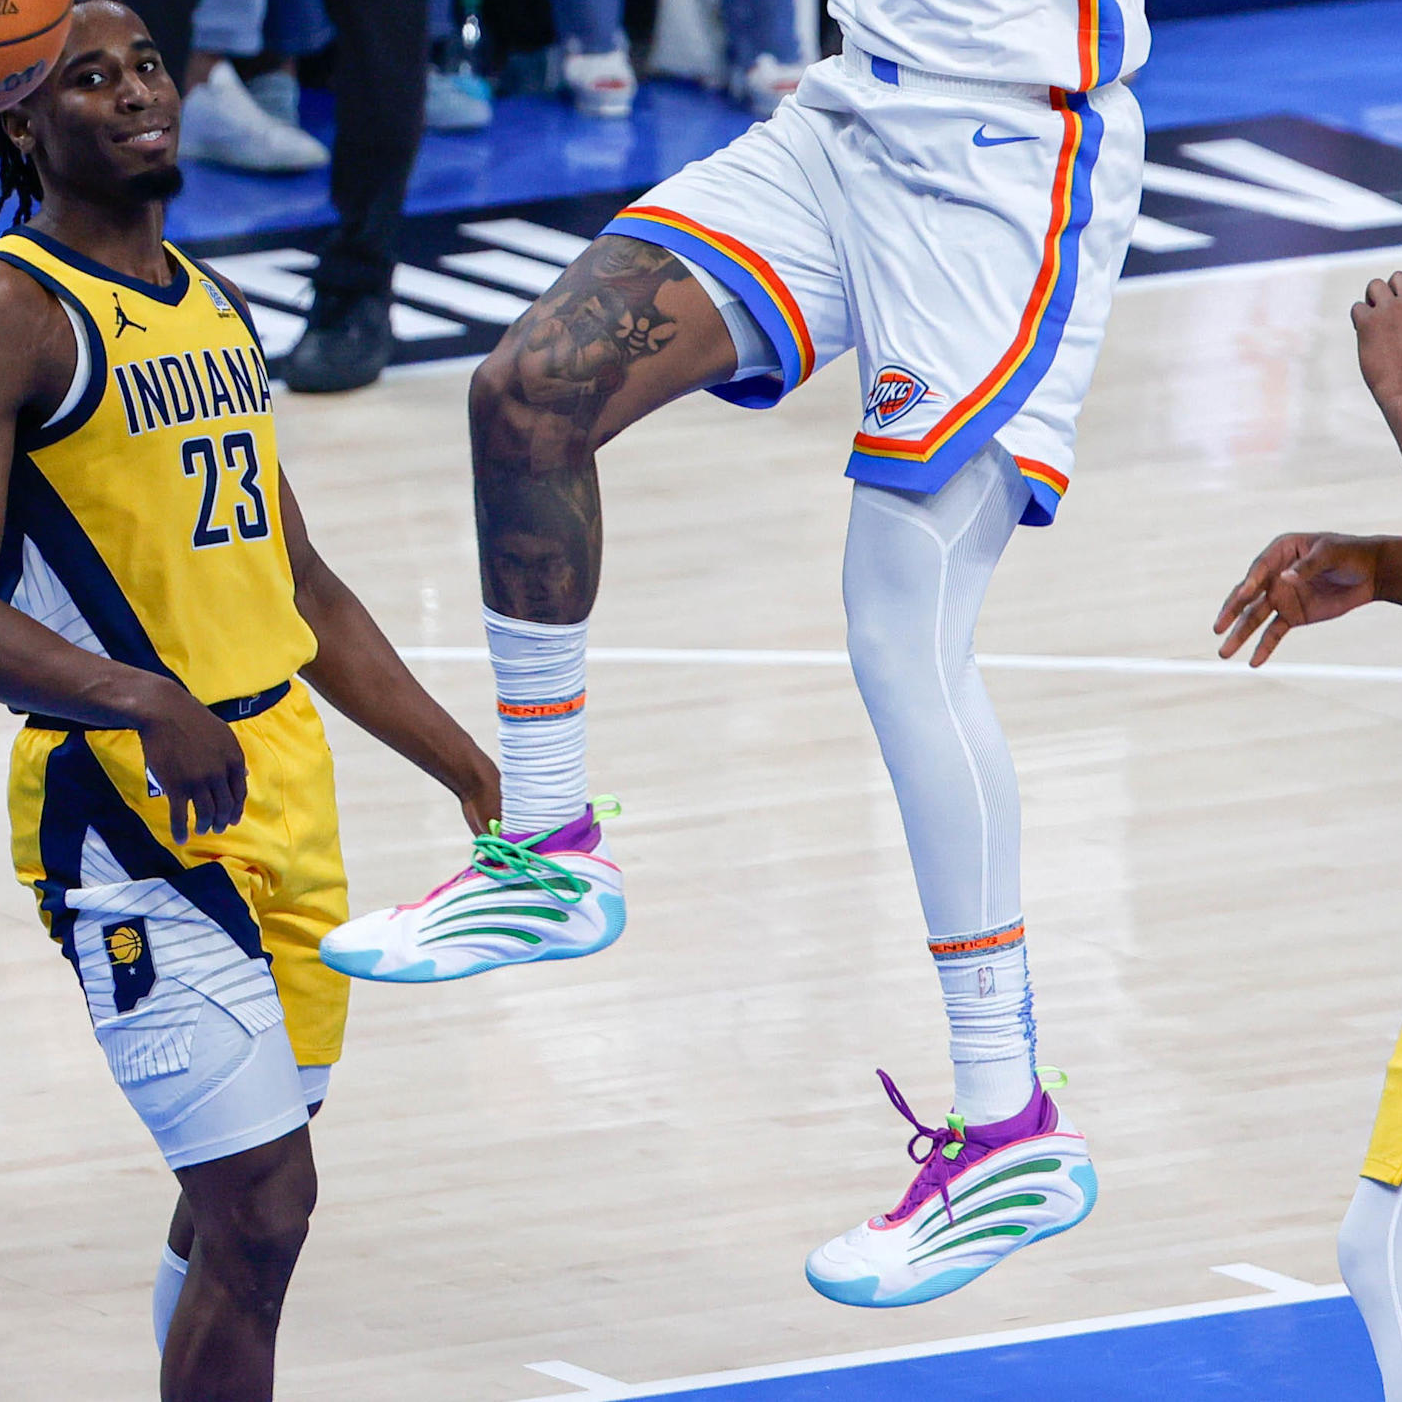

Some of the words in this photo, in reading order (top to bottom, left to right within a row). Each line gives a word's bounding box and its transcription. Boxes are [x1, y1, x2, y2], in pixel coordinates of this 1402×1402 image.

[112, 346, 275, 438] INDIANA
[862, 380, 914, 414] OKC
[179, 428, 271, 551] 23
